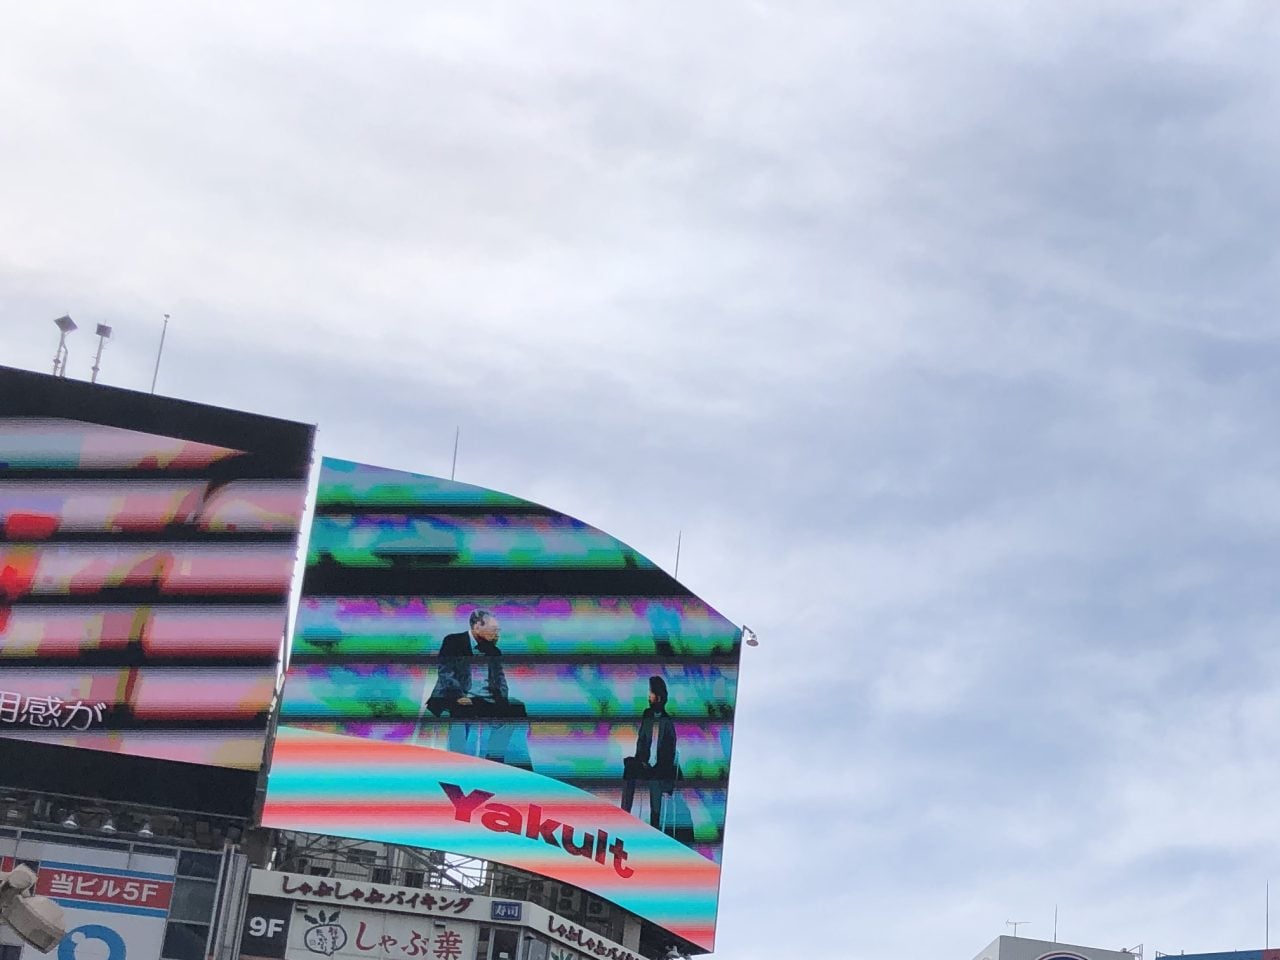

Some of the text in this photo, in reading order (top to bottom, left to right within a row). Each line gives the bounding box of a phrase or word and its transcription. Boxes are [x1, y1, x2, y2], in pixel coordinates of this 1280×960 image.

[438, 781, 634, 879] Yakult
[50, 873, 159, 903] 当ビル5F
[282, 875, 475, 914] しゃぶしゃぶバイキング
[249, 916, 285, 938] 9F
[356, 921, 463, 960] しゃぶ葉
